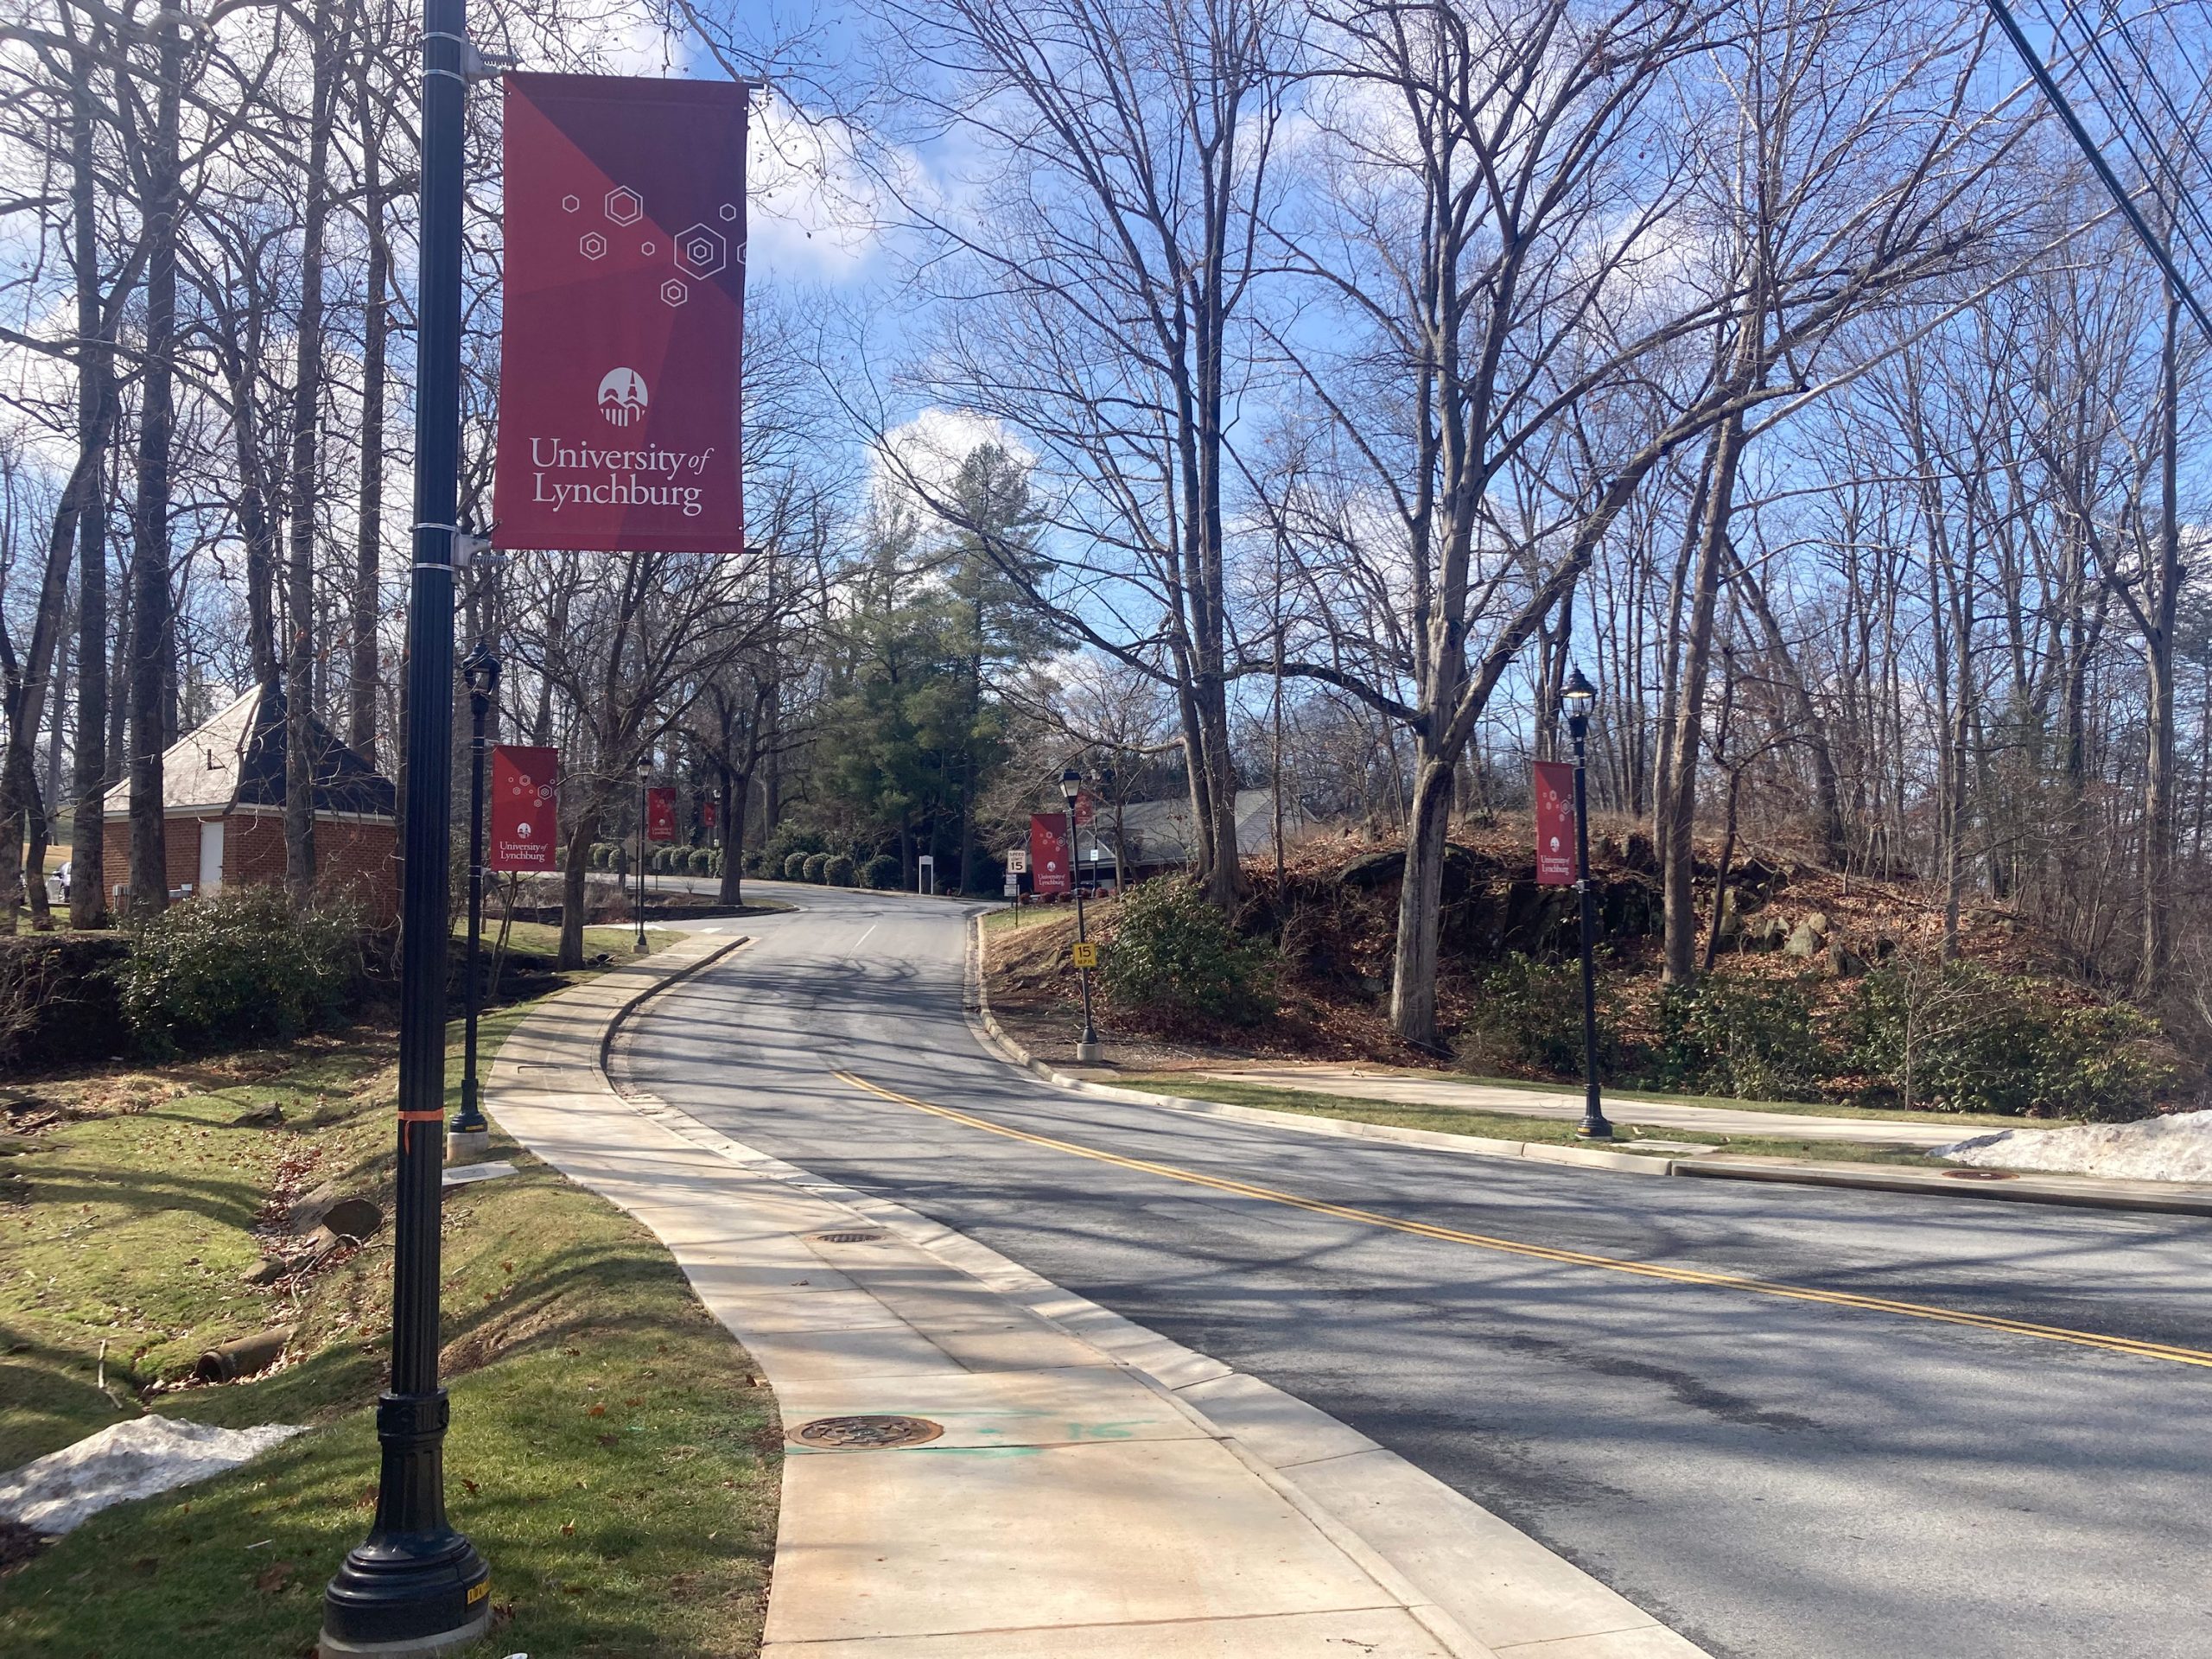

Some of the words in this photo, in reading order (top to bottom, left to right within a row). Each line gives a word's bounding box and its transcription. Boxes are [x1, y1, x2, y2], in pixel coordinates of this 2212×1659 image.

[529, 437, 687, 480] University
[688, 448, 715, 475] of
[531, 473, 702, 517] Lynchburg
[499, 841, 540, 853] University
[541, 843, 549, 852] of
[500, 850, 545, 862] Lynchburg
[1011, 861, 1023, 871] 15
[1077, 946, 1091, 958] 15
